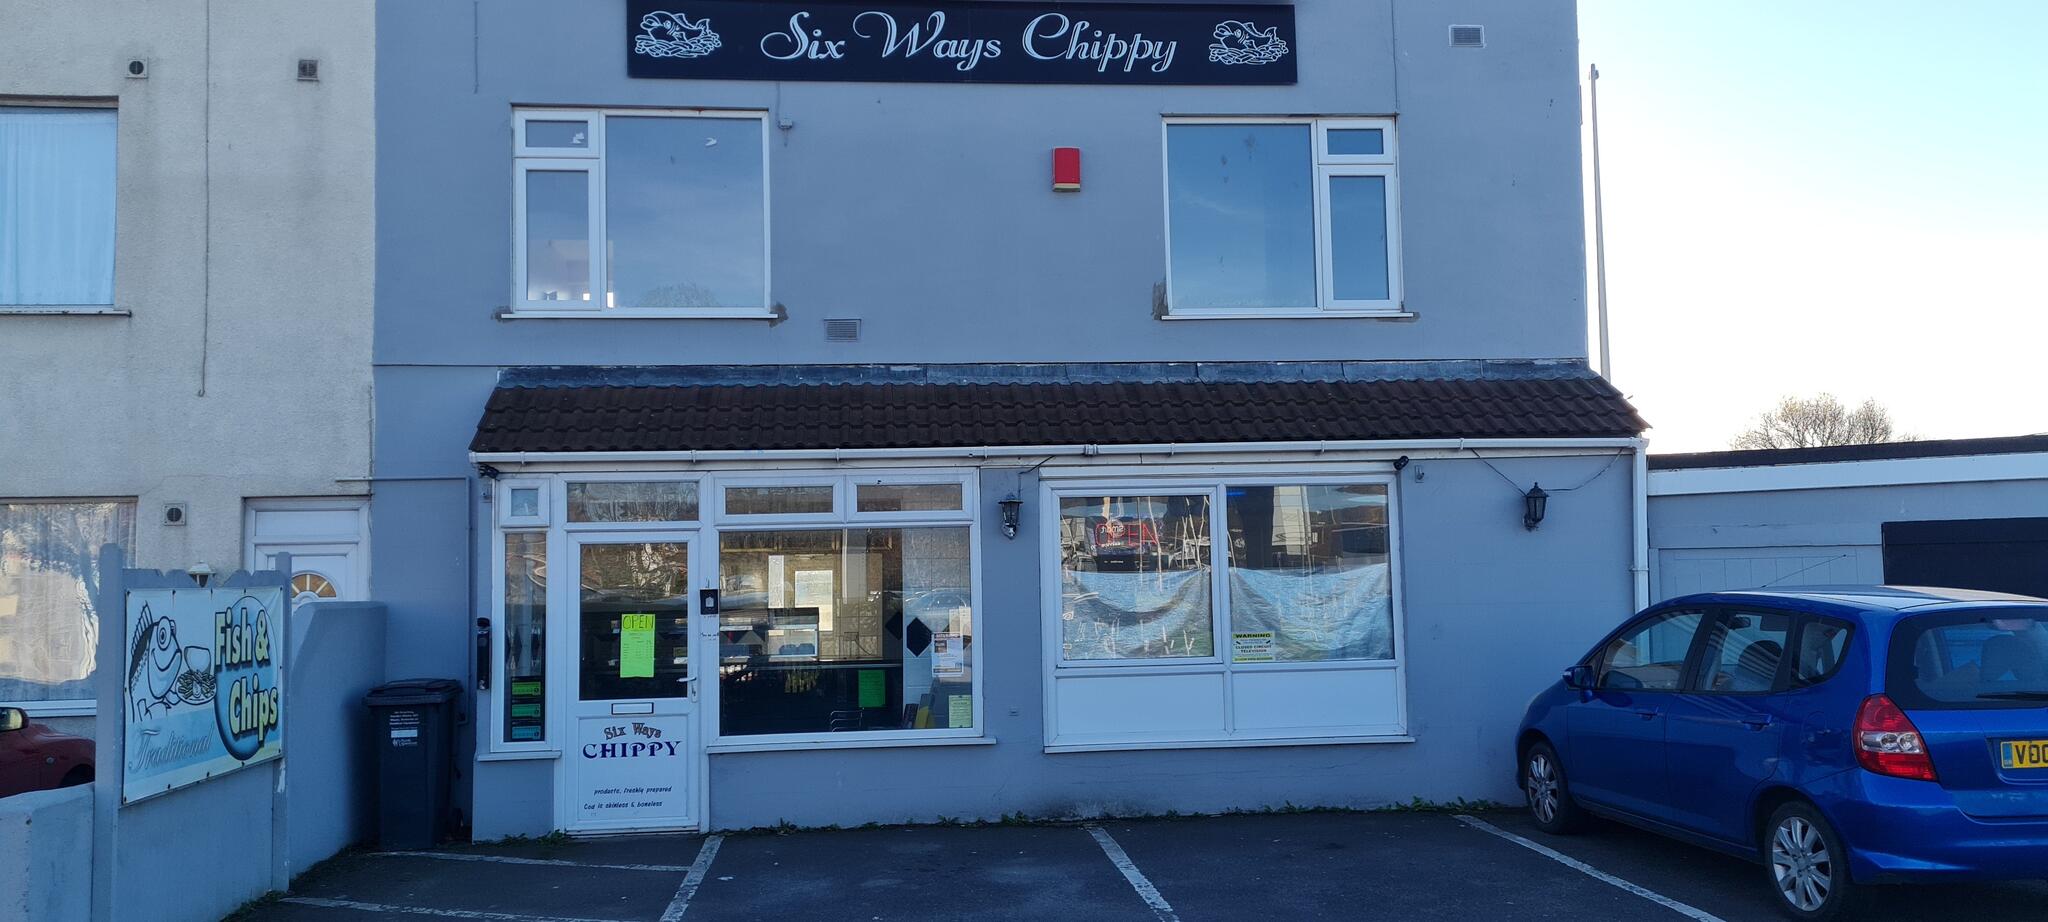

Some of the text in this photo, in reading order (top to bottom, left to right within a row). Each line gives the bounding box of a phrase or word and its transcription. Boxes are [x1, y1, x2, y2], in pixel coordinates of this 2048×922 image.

[760, 11, 1178, 72] Six Ways Chippy
[623, 615, 653, 629] OPEN
[214, 606, 271, 671] Fish &
[229, 673, 279, 744] Chips
[604, 722, 661, 740] Six Ways
[128, 721, 215, 774] Traditional
[582, 741, 682, 759] CHIPPY
[623, 786, 644, 794] freshly
[646, 786, 672, 794] prepared
[637, 800, 663, 808] boneless
